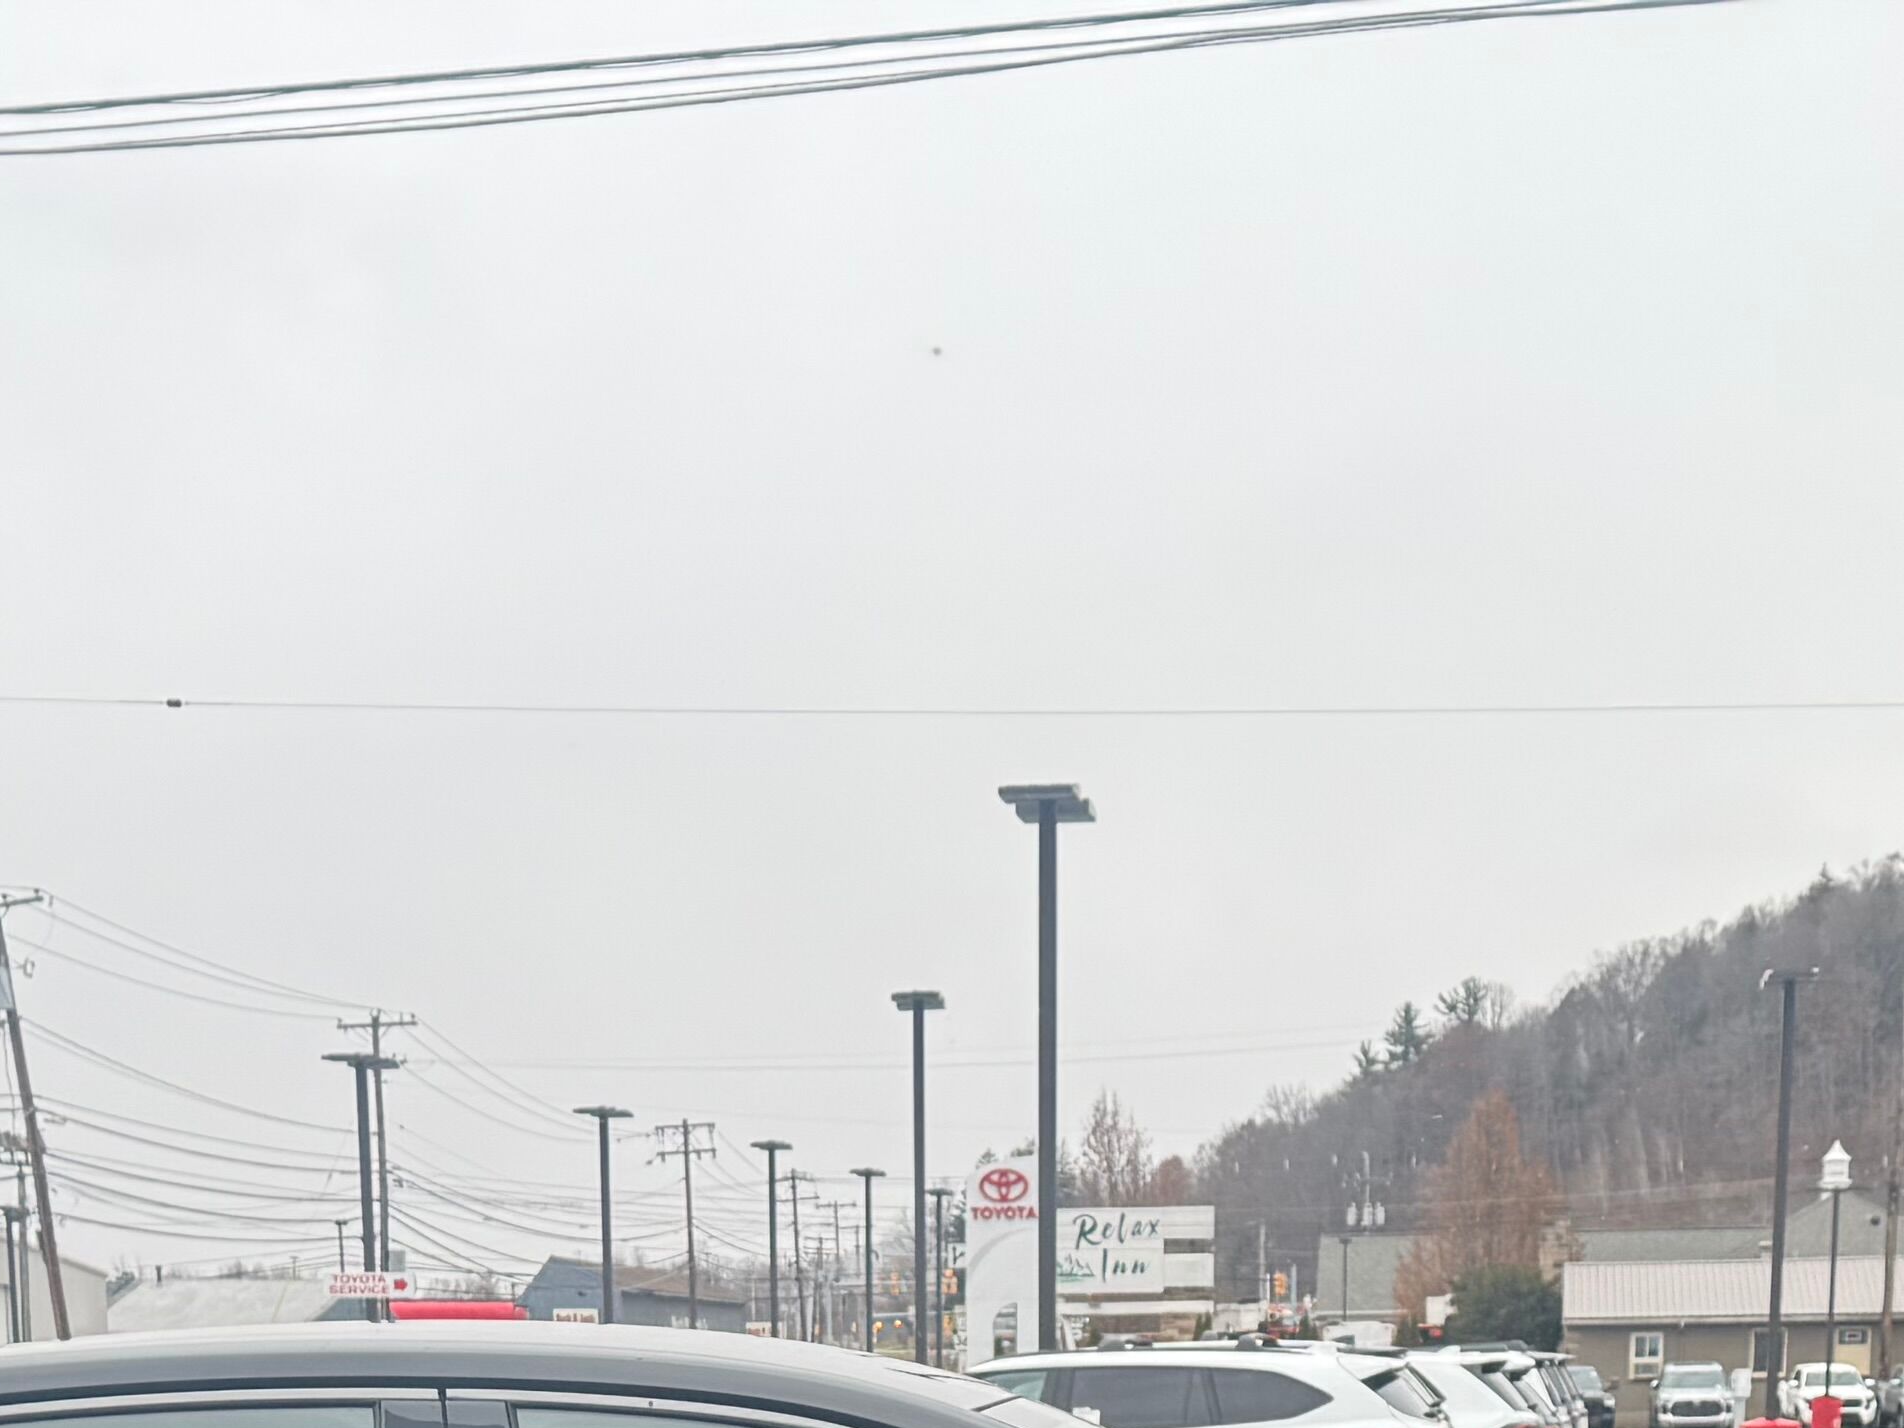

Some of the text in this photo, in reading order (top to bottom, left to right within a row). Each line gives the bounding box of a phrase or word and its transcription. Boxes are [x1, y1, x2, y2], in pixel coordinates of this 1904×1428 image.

[971, 1206, 1039, 1220] TOYOTA
[1073, 1212, 1160, 1250] Relax
[1102, 1248, 1147, 1283] Inn
[332, 1273, 386, 1284] TOYOTA
[329, 1285, 389, 1294] SERVICE
